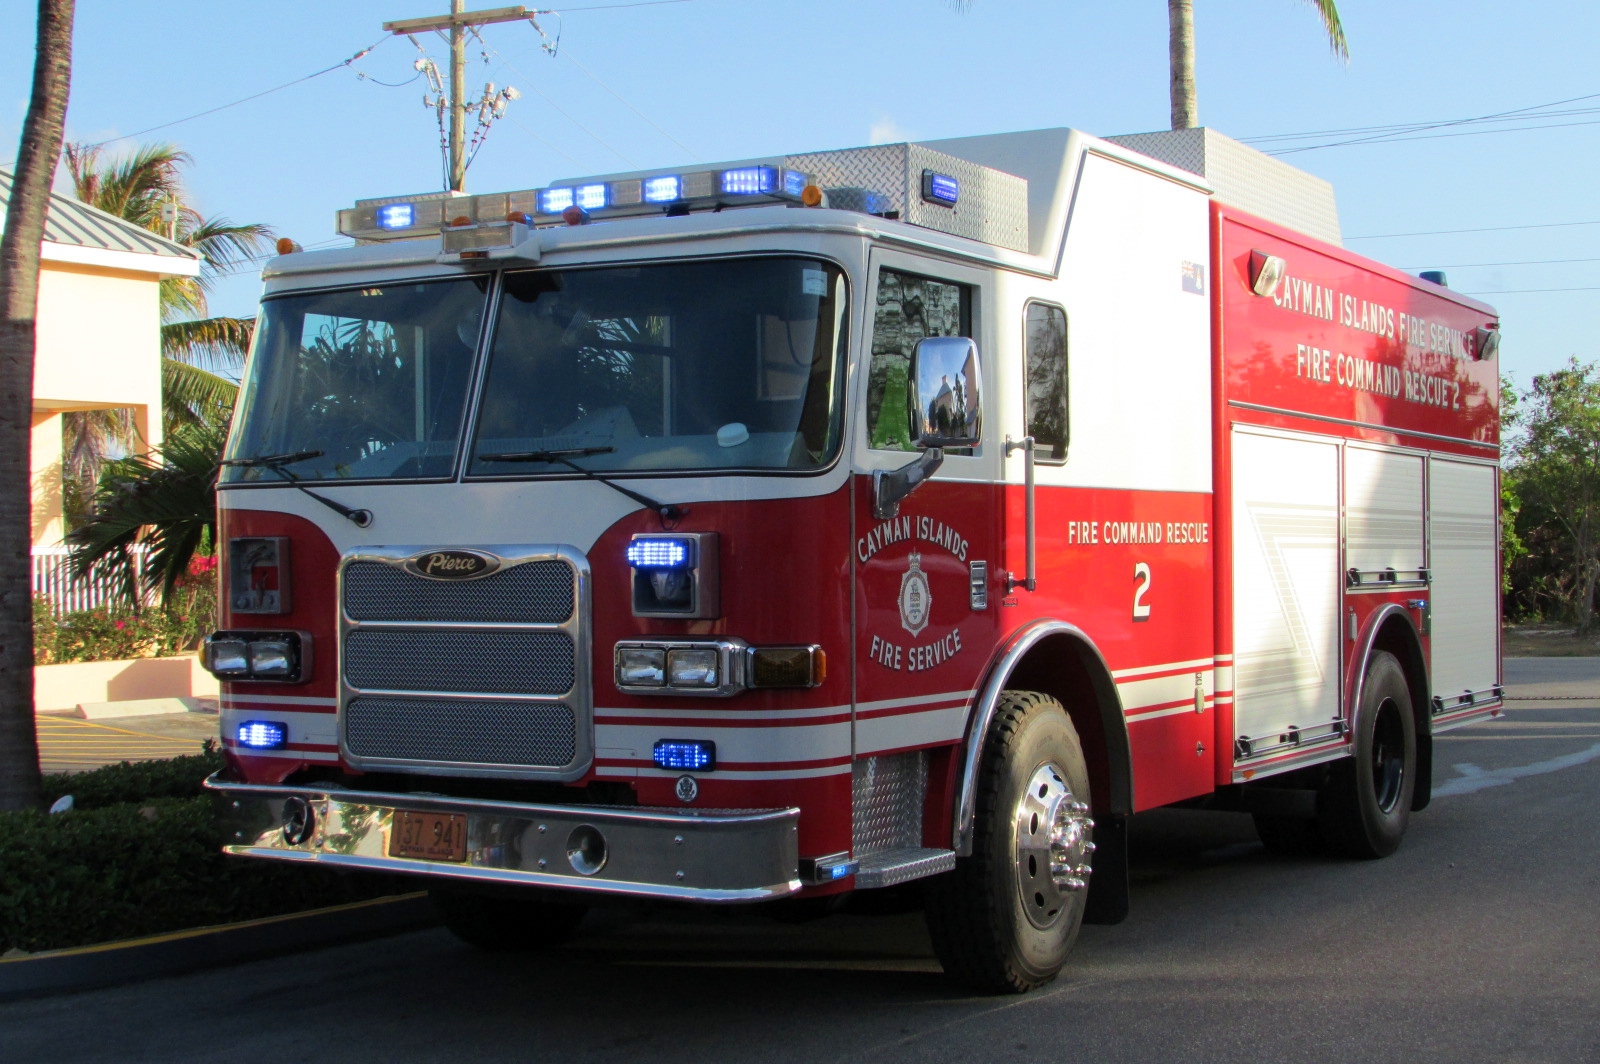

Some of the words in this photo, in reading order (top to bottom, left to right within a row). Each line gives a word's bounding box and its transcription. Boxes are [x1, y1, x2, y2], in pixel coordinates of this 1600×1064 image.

[1339, 293, 1395, 340] ISLANDS
[1399, 313, 1426, 350] FIRE
[1430, 323, 1474, 362] SERVICE
[1297, 344, 1331, 383] FIRE
[1336, 352, 1400, 399] COMMAND
[1405, 370, 1449, 408] RESCUE
[1452, 385, 1460, 411] 2
[857, 516, 911, 563] CAYMAN
[916, 516, 969, 562] ISLANDS
[1068, 521, 1098, 545] FIRE
[1103, 521, 1162, 545] COMMAND
[1167, 522, 1209, 544] RESCUE
[426, 553, 477, 574] Pierce
[1133, 562, 1151, 620] 2
[869, 635, 902, 670] FIRE
[908, 628, 962, 672] SERVICE
[433, 821, 461, 849] 941
